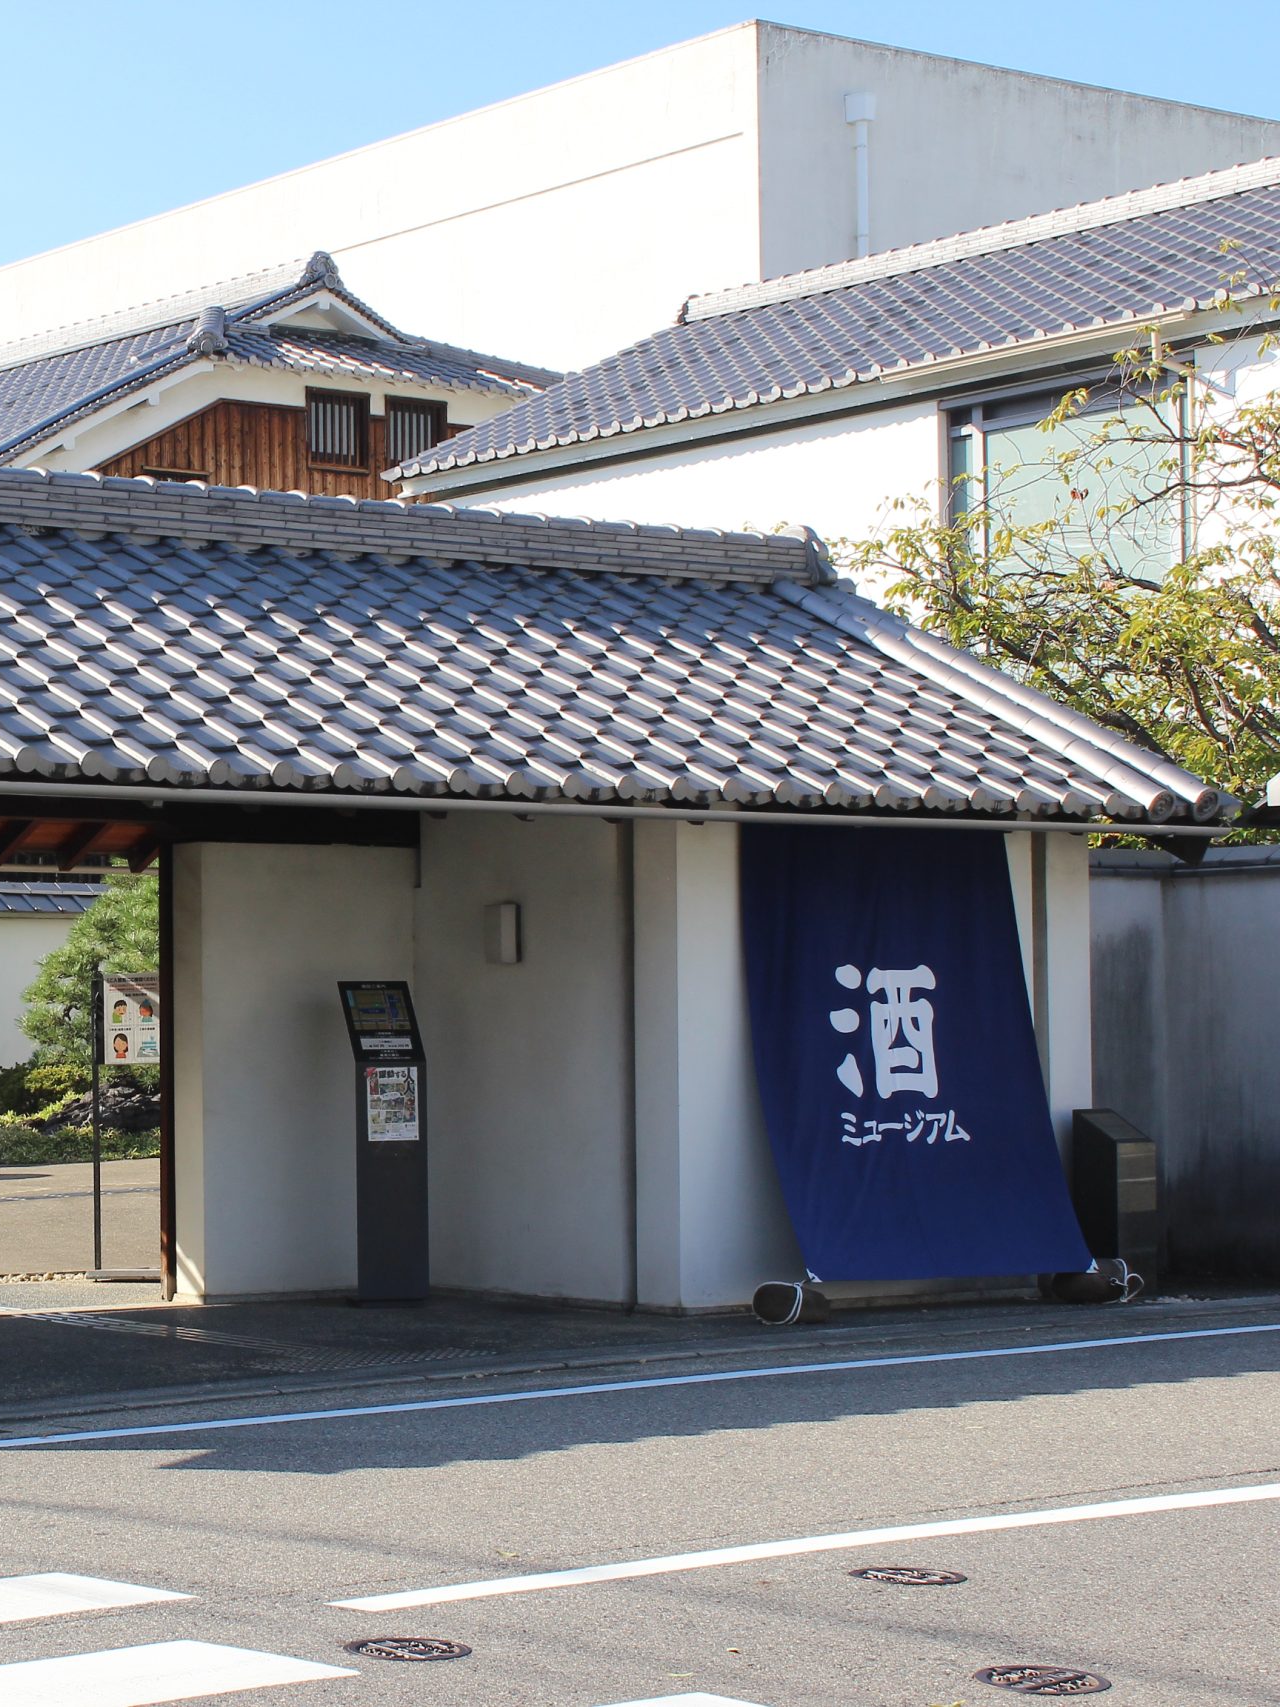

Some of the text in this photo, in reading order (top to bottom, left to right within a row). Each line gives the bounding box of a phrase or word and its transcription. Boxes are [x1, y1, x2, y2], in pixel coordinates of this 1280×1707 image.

[829, 964, 939, 1100] 酒
[840, 1109, 971, 1147] ミュージアム
